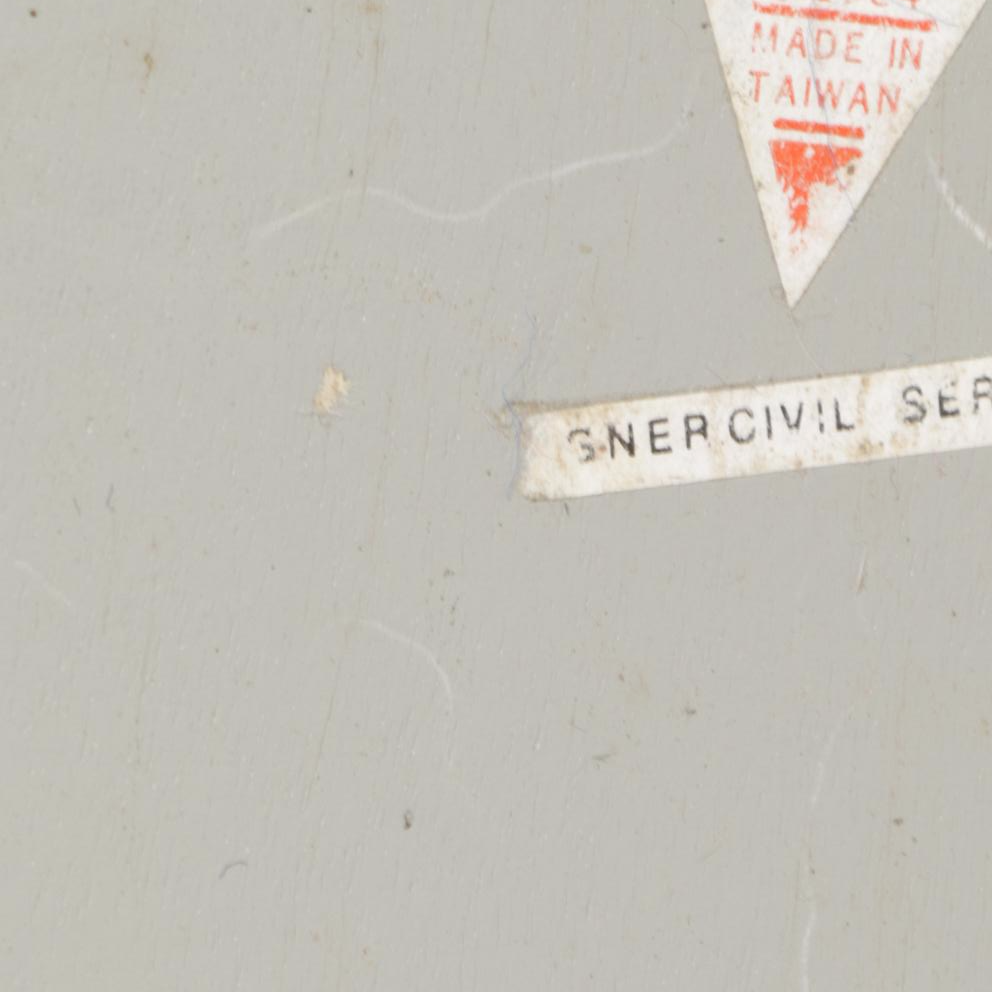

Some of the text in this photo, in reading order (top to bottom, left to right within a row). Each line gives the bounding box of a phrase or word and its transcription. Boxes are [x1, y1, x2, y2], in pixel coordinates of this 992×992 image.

[751, 21, 923, 72] MADE IN
[748, 70, 901, 116] TAIWAN
